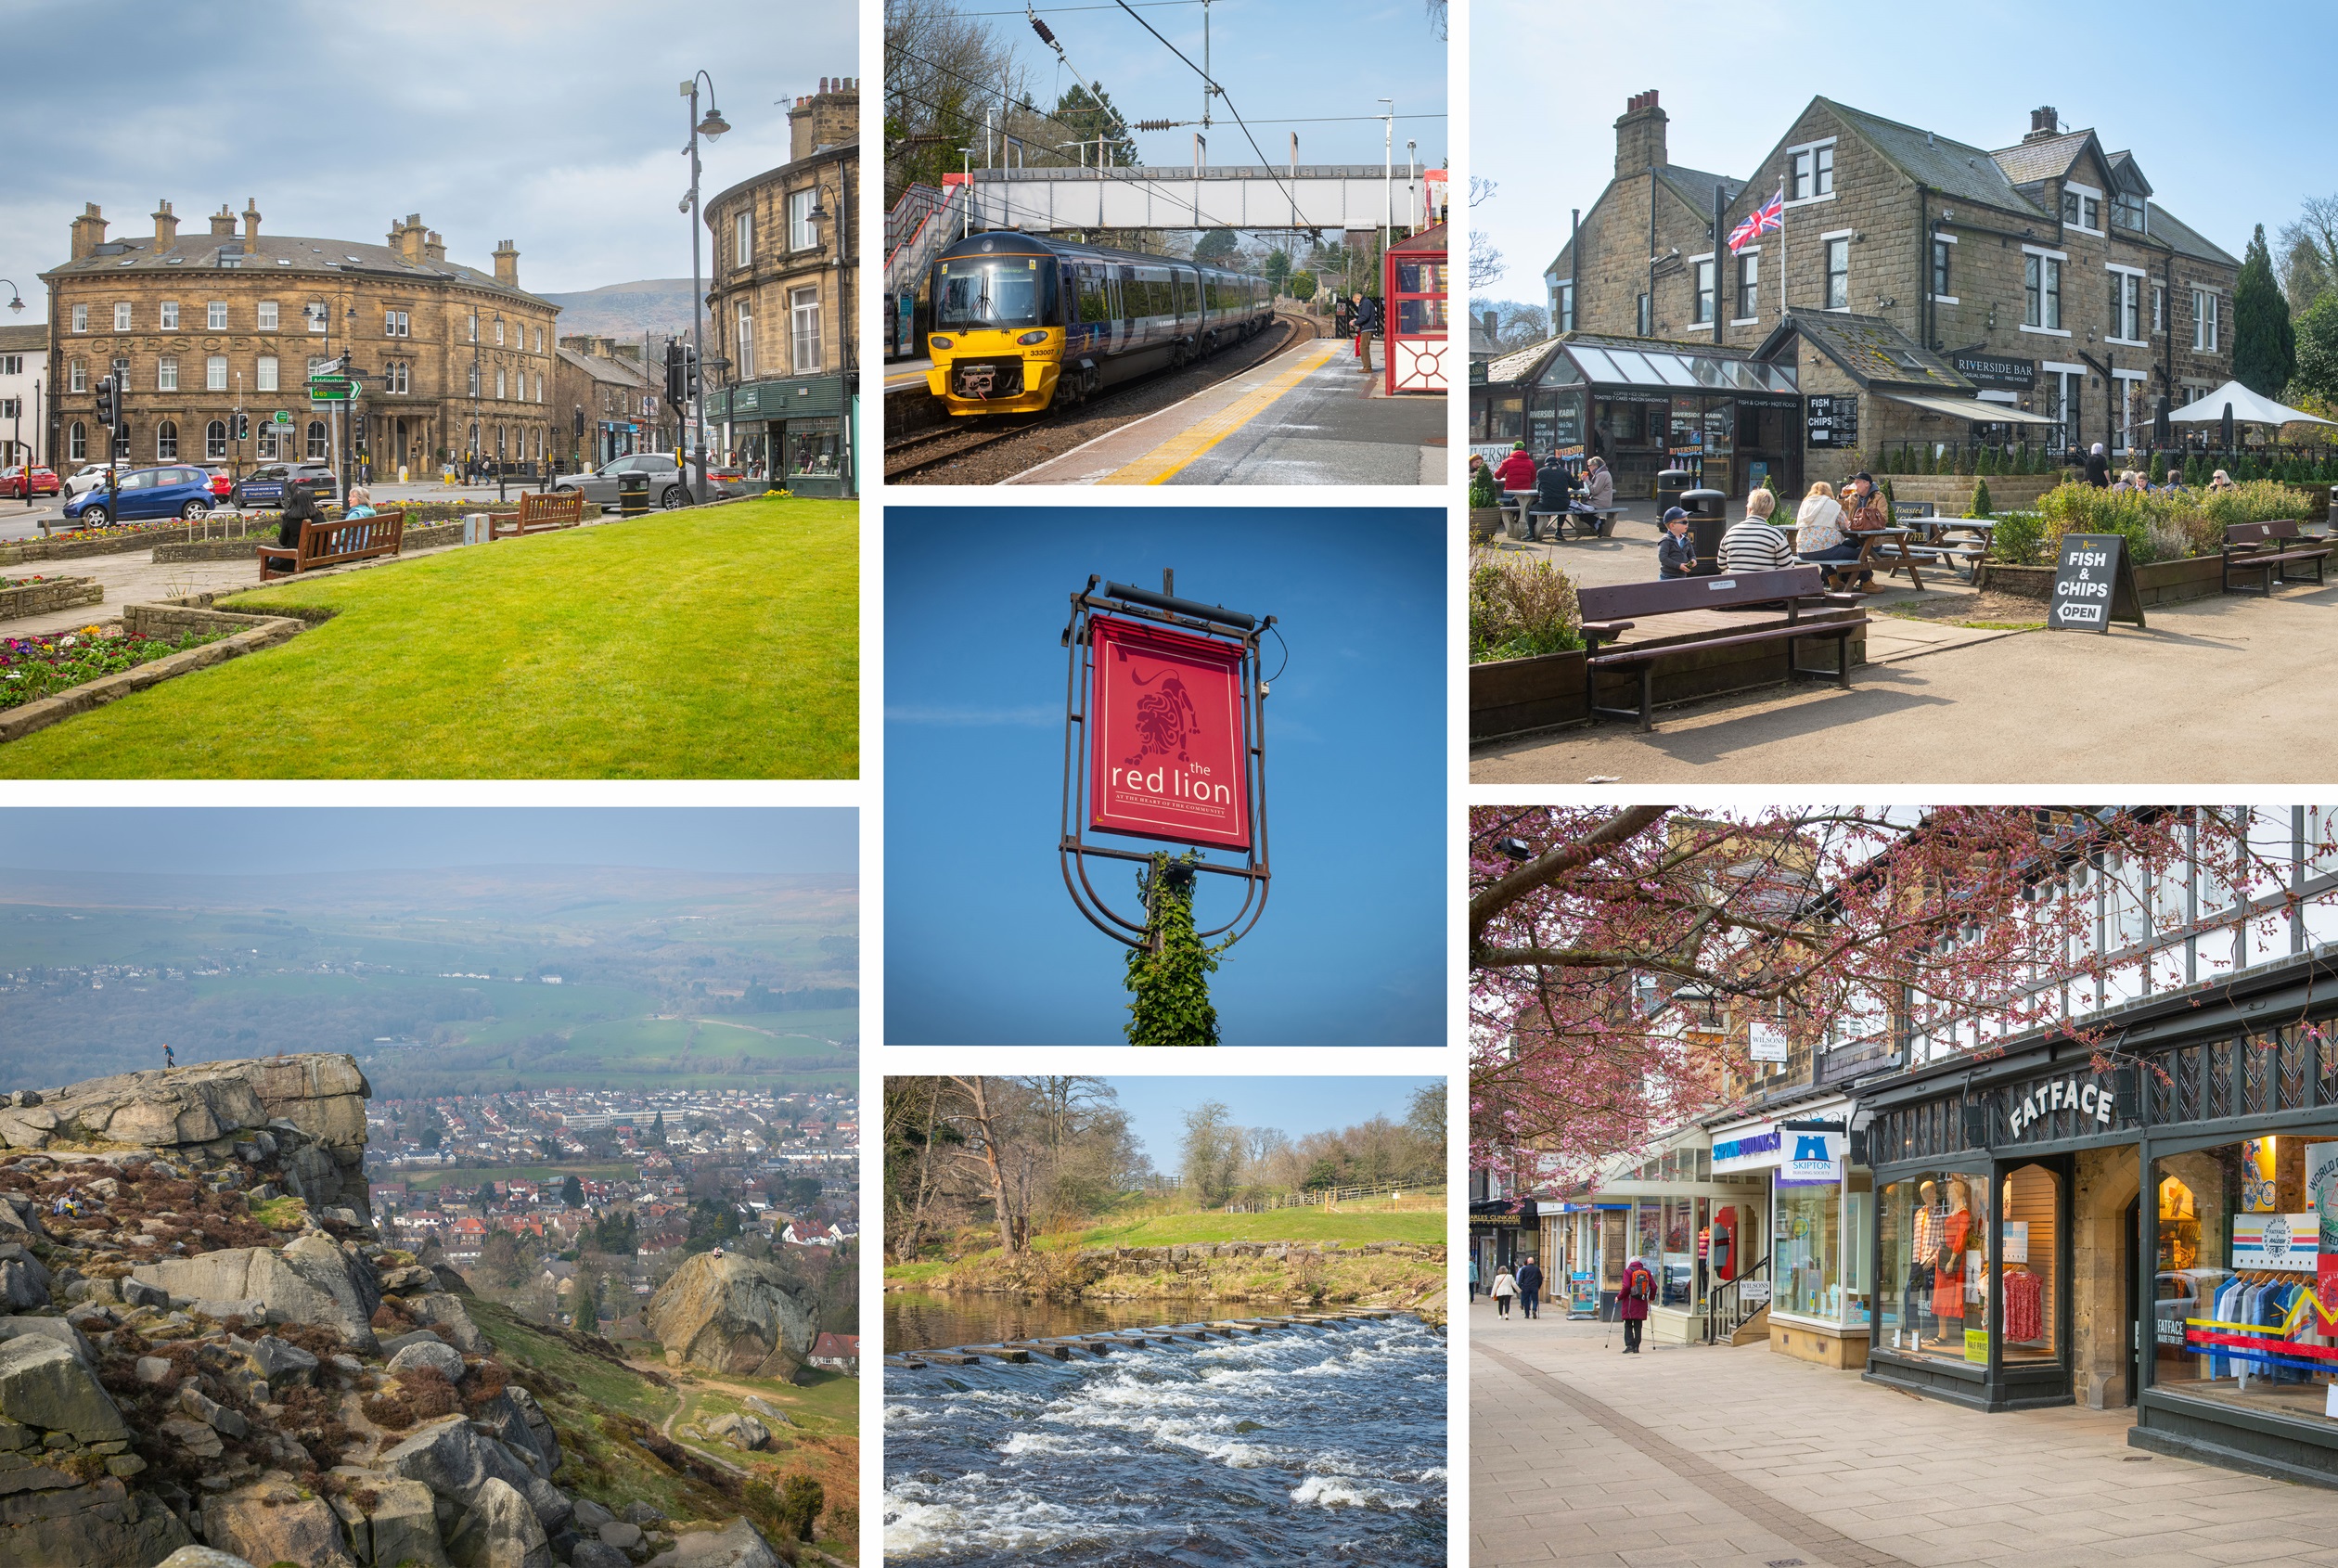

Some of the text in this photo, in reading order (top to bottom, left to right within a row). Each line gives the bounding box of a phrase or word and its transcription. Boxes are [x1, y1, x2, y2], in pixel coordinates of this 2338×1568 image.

[91, 336, 308, 353] CRESCENT
[477, 349, 536, 369] HOTEL
[1959, 359, 2032, 376] RIVERSIDE BAR
[1811, 399, 1829, 407] FISH
[1808, 417, 1832, 426] CHIPS
[1555, 445, 1584, 458] RIVERSIDE
[1669, 446, 1703, 455] RIVERSIDE
[1895, 506, 1925, 514] Toasted
[2068, 552, 2106, 566] FISH
[2079, 568, 2090, 580] &
[2057, 581, 2108, 598] CHIPS
[2062, 606, 2096, 618] OPEN
[1190, 762, 1210, 776] the
[1113, 767, 1230, 804] red lion
[1185, 804, 1225, 815] COMMUNITY
[2009, 1080, 2113, 1139] FATFACE
[1712, 1140, 1740, 1161] SKIPTON
[2308, 1161, 2334, 1191] WORLD
[2320, 1273, 2332, 1293] GRAB
[2157, 1319, 2183, 1335] FATFACE
[2157, 1334, 2168, 1343] MADE
[1977, 1342, 1988, 1351] PRICE
